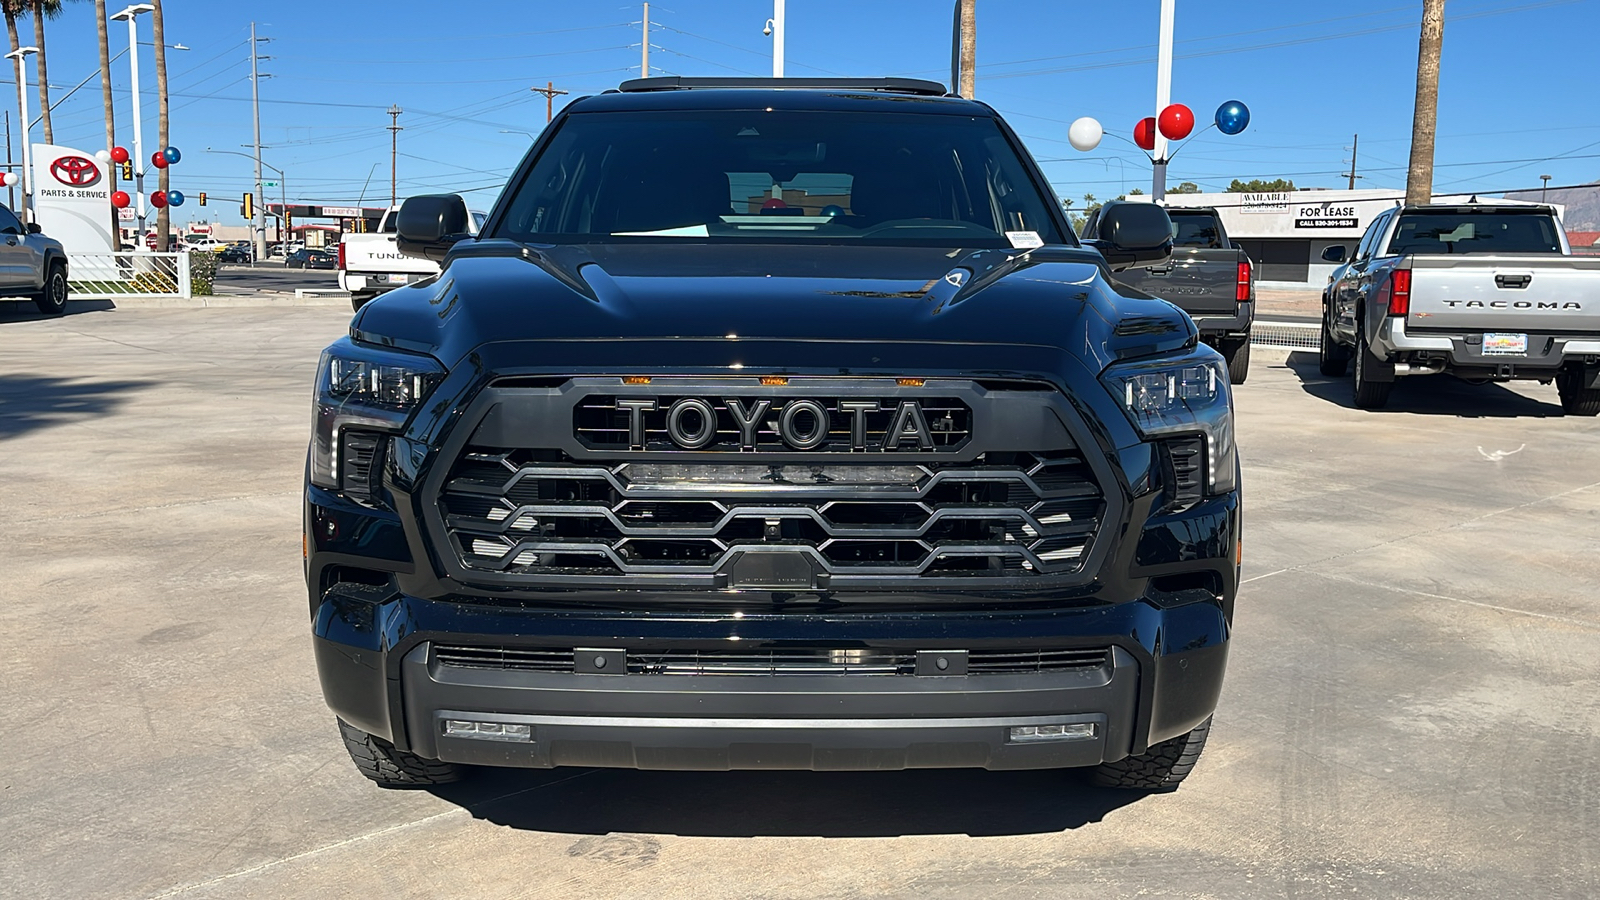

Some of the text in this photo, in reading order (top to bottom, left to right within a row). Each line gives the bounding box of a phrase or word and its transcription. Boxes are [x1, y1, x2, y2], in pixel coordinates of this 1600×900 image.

[41, 189, 108, 199] PARTS & SERVICE
[1242, 193, 1289, 202] AVAILABLE
[1300, 207, 1355, 217] FOR LEASE
[1442, 299, 1582, 310] TACOMA
[615, 397, 936, 452] TOYOTA
